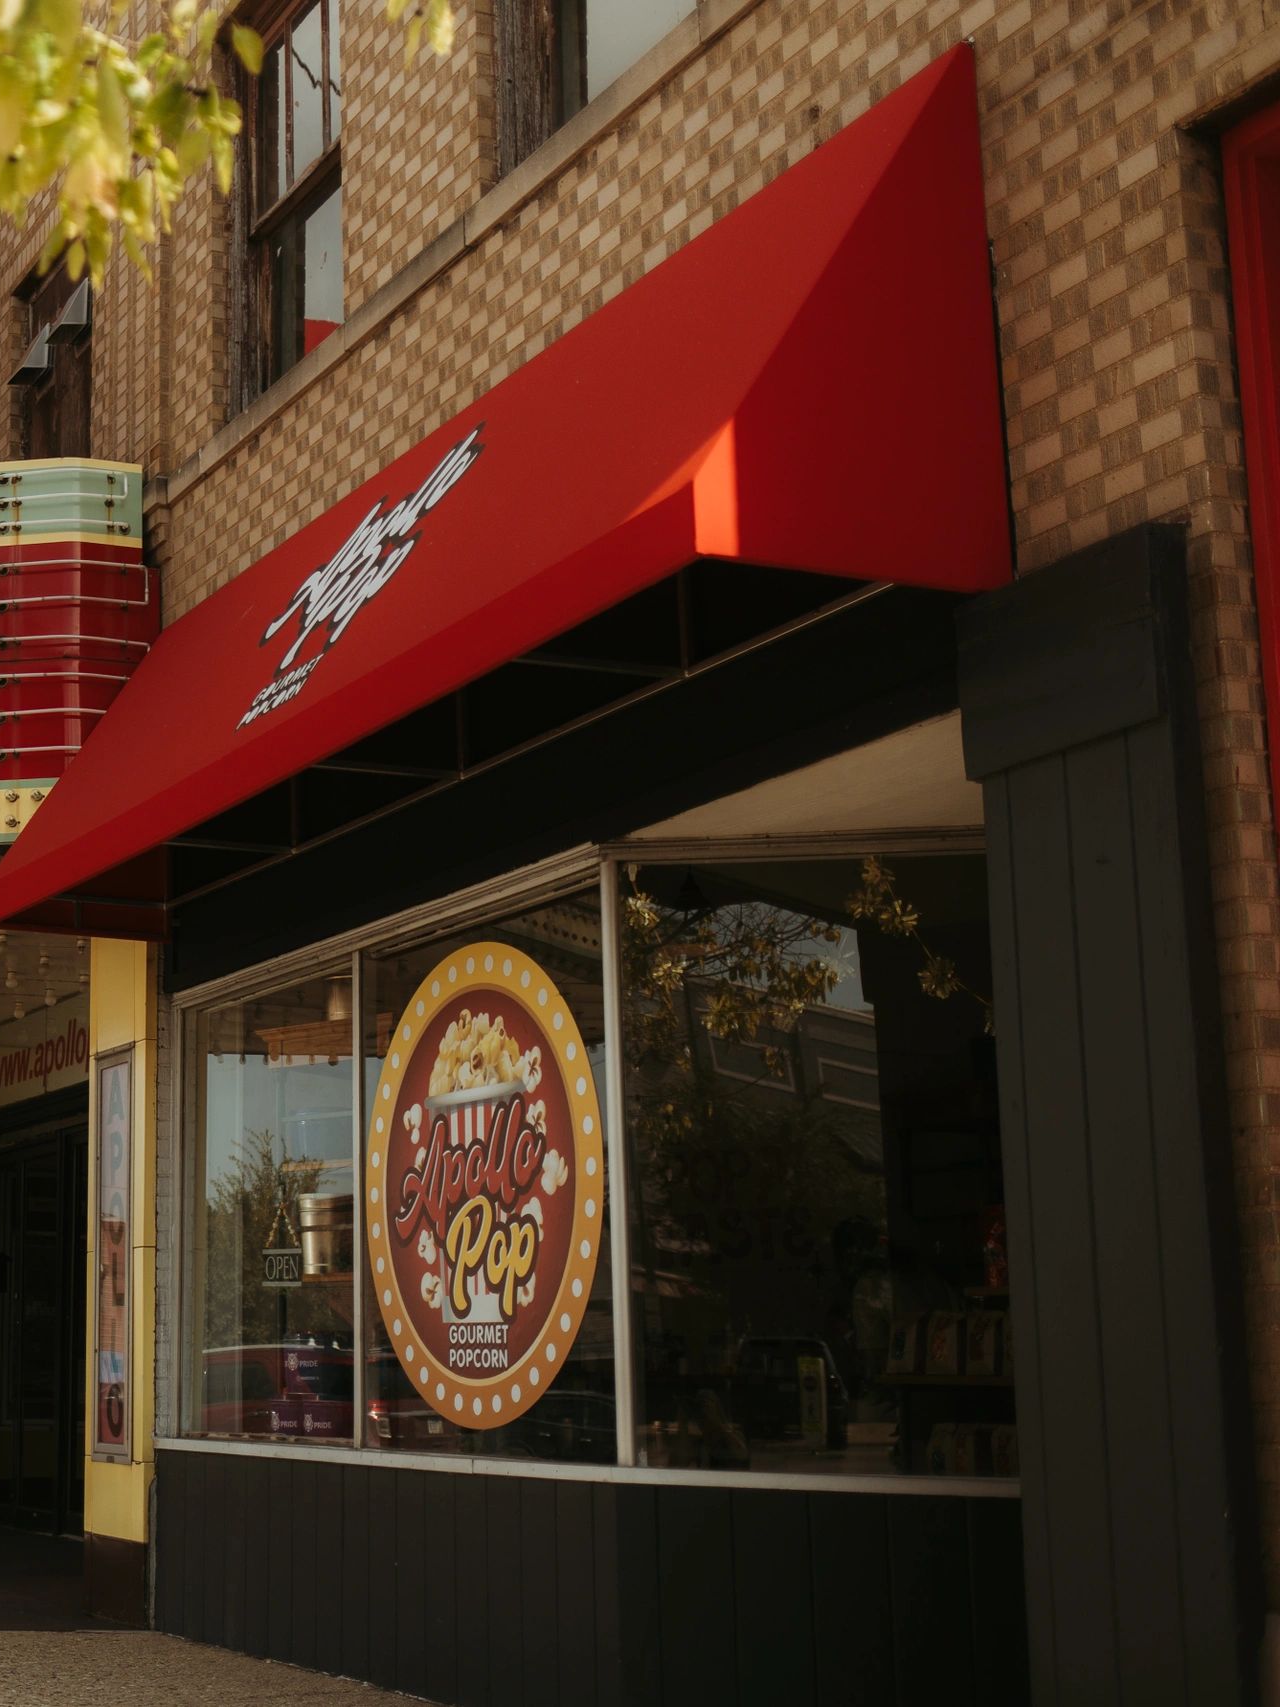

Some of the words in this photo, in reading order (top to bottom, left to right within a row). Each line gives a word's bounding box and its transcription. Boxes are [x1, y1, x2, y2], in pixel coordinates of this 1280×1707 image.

[251, 653, 325, 707] GOURMET
[235, 677, 308, 731] POPCORN
[395, 1098, 545, 1240] Apollo
[265, 1253, 299, 1282] OPEN
[446, 1195, 535, 1316] Pop
[449, 1324, 509, 1344] GOURMET
[299, 1360, 319, 1368] PRIDE
[449, 1348, 509, 1368] POPCORN
[313, 1421, 332, 1429] PRIDE
